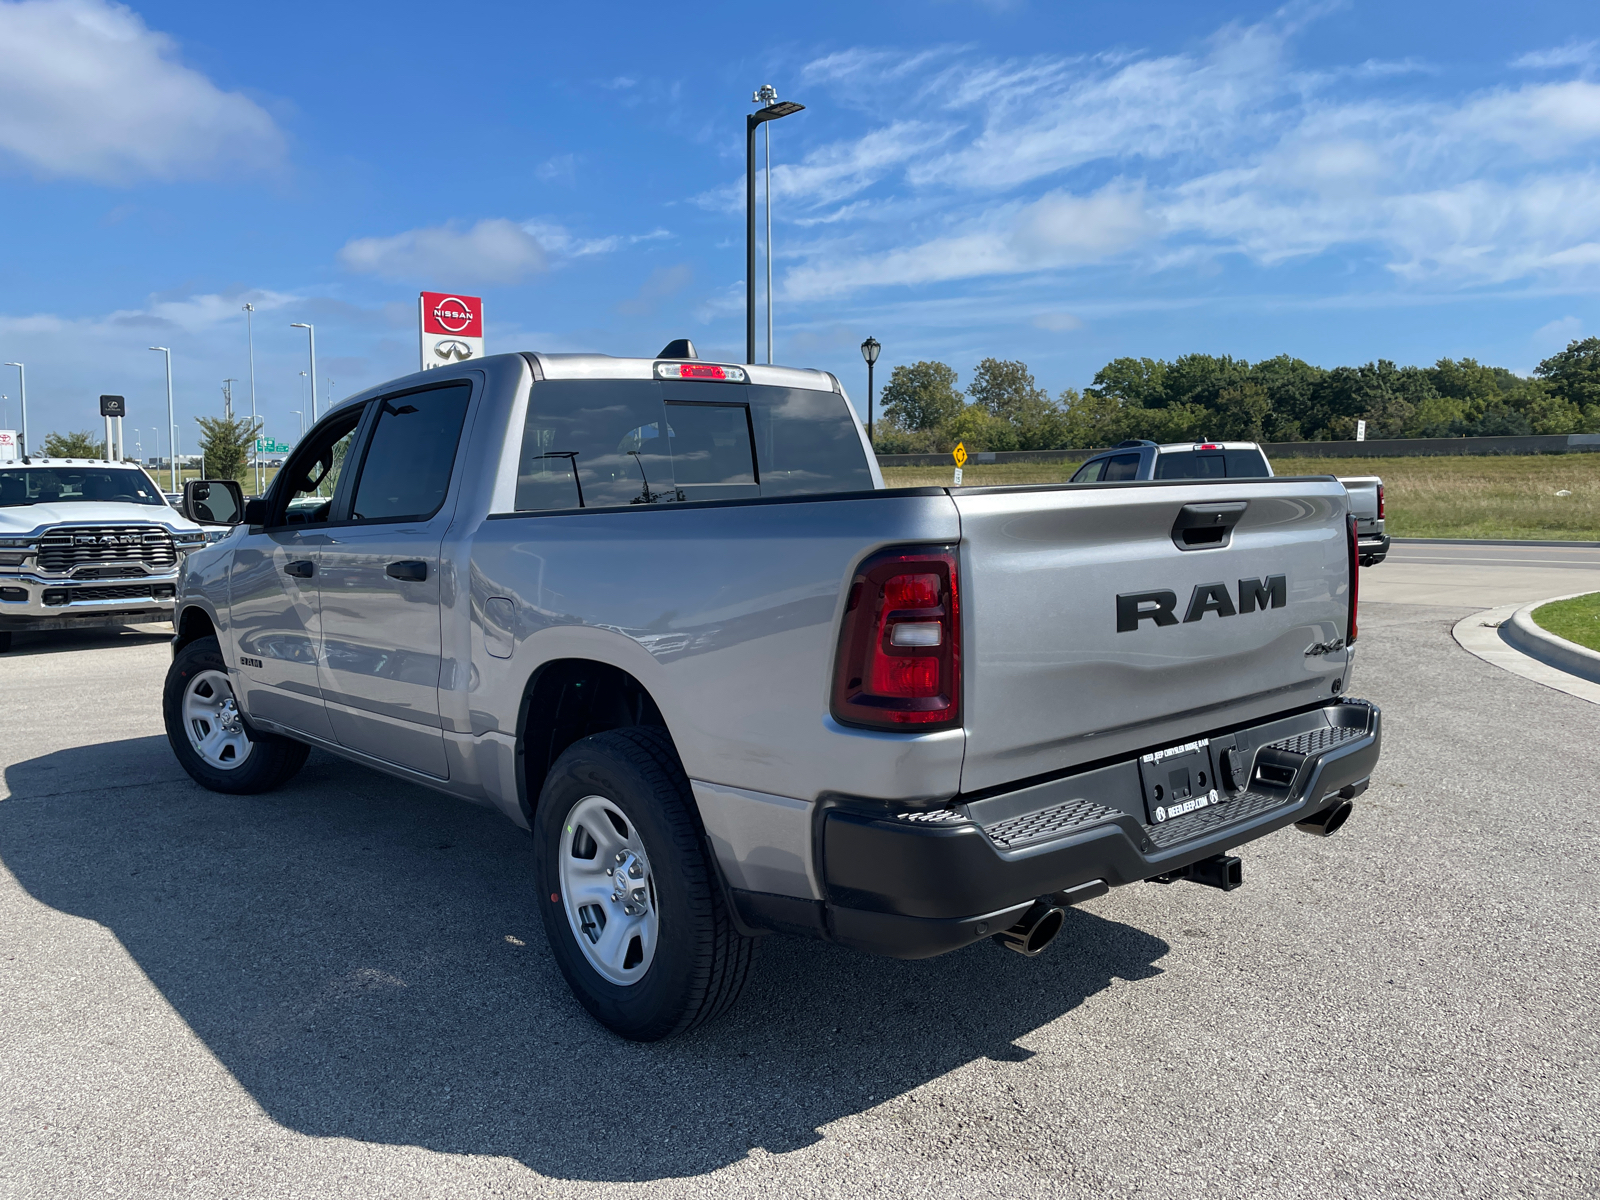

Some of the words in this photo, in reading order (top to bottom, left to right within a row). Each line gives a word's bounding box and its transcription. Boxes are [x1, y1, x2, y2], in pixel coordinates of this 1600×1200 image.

[433, 310, 473, 320] NISSAN
[75, 535, 142, 545] RAM
[1116, 573, 1286, 633] RAM
[240, 656, 263, 668] RAM
[1198, 738, 1209, 748] RAM
